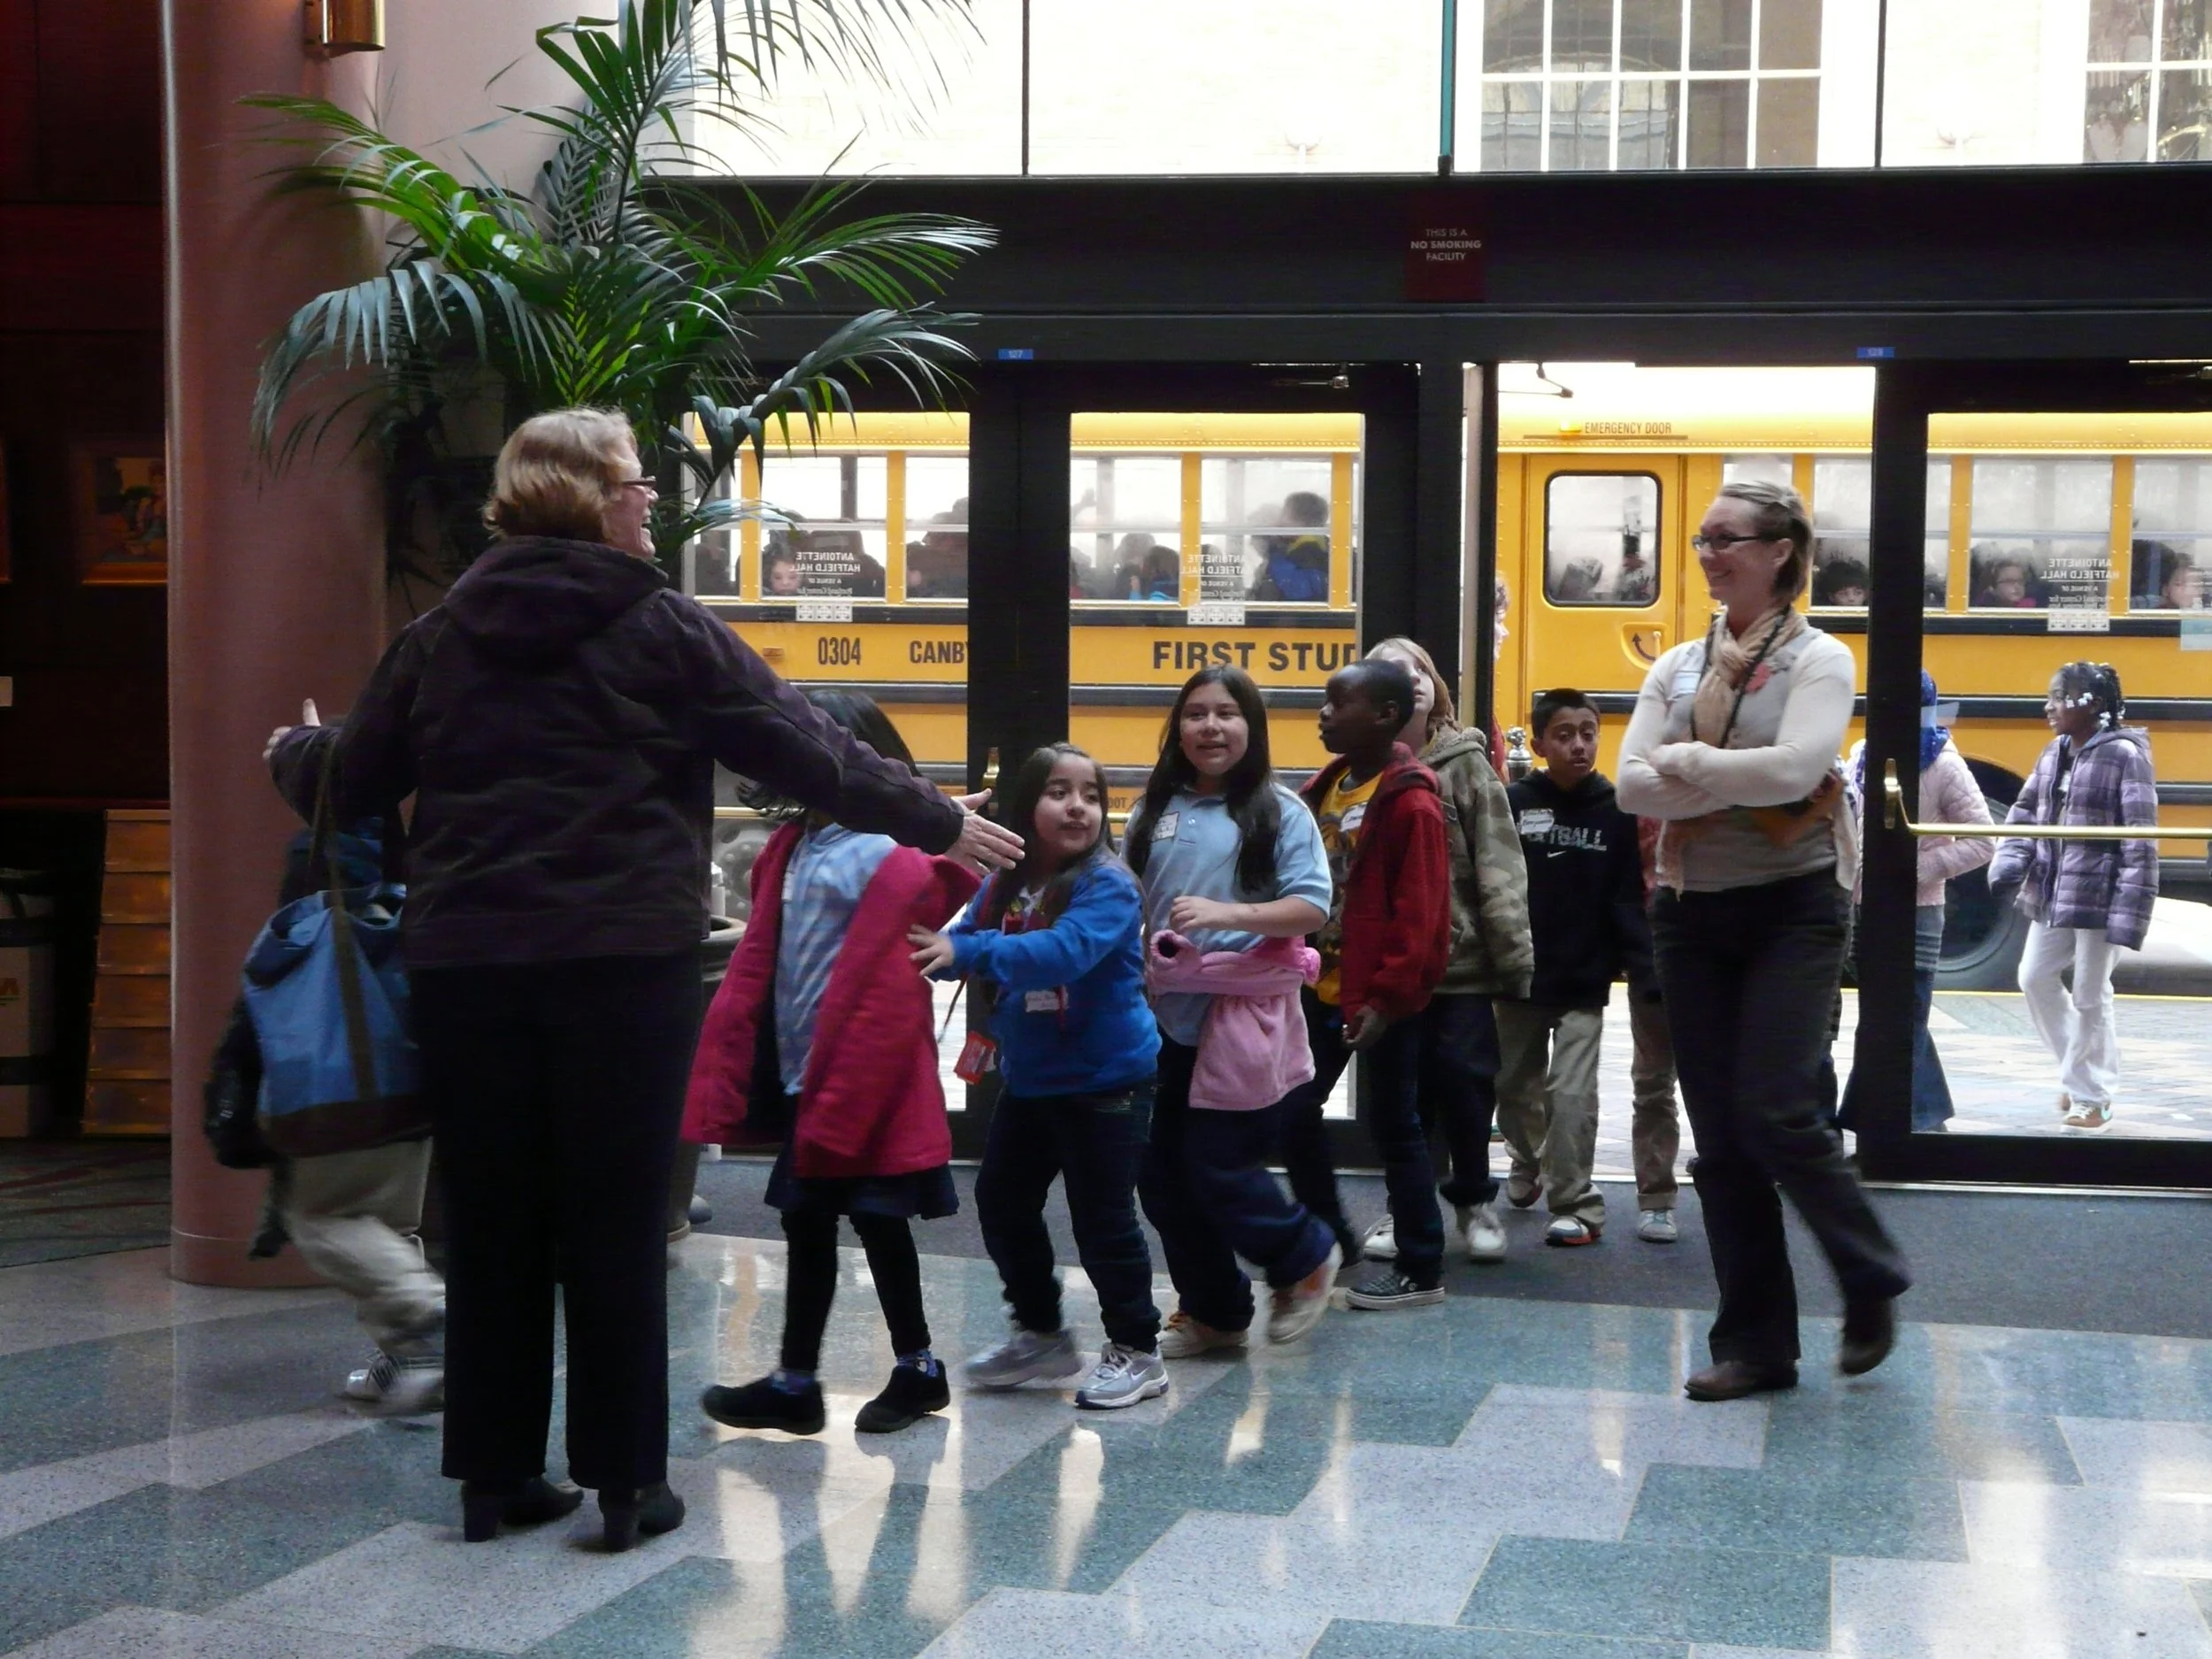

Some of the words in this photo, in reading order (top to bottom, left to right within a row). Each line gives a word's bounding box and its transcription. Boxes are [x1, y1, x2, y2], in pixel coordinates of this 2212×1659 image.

[1425, 228, 1447, 237] THIS
[1449, 228, 1458, 237] IS
[1410, 240, 1428, 249] NO
[1431, 240, 1482, 249] SMOKING
[1425, 252, 1467, 261] FACILITY
[1585, 421, 1642, 434] EMERGENCY
[1645, 421, 1672, 434] DOOR
[818, 637, 862, 665] 0304
[910, 641, 969, 664] CANB
[1153, 641, 1256, 670] FIRST
